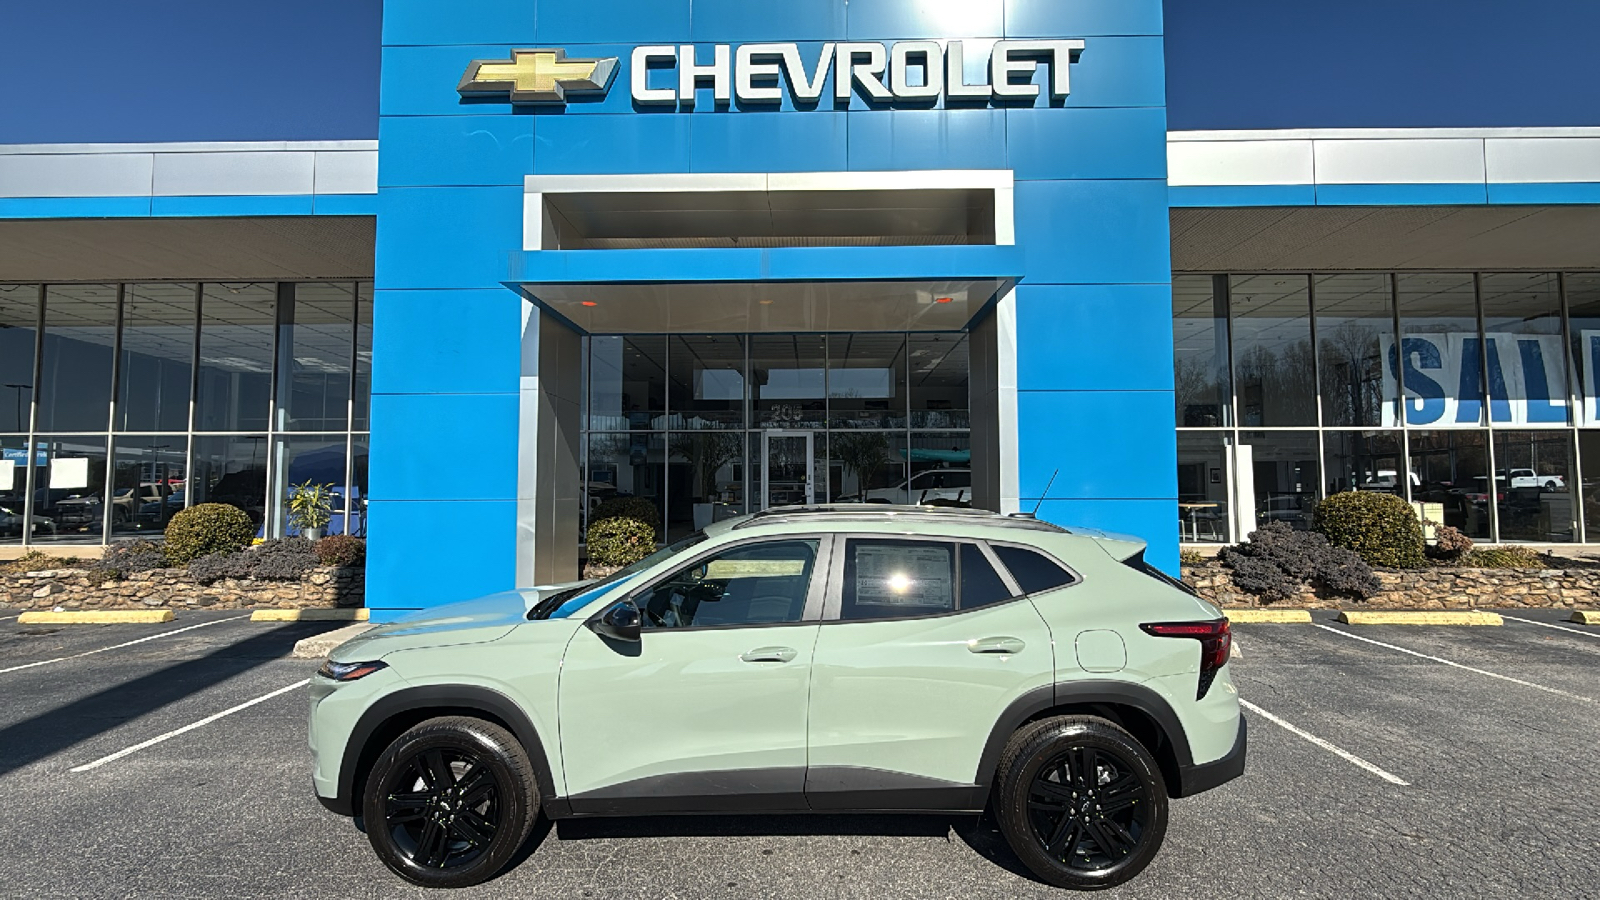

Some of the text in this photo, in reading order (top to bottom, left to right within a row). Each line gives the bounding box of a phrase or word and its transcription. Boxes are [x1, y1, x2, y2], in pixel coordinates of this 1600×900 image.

[631, 39, 1086, 108] CHEVROLET
[771, 404, 803, 420] 205
[1388, 335, 1600, 425] SAL
